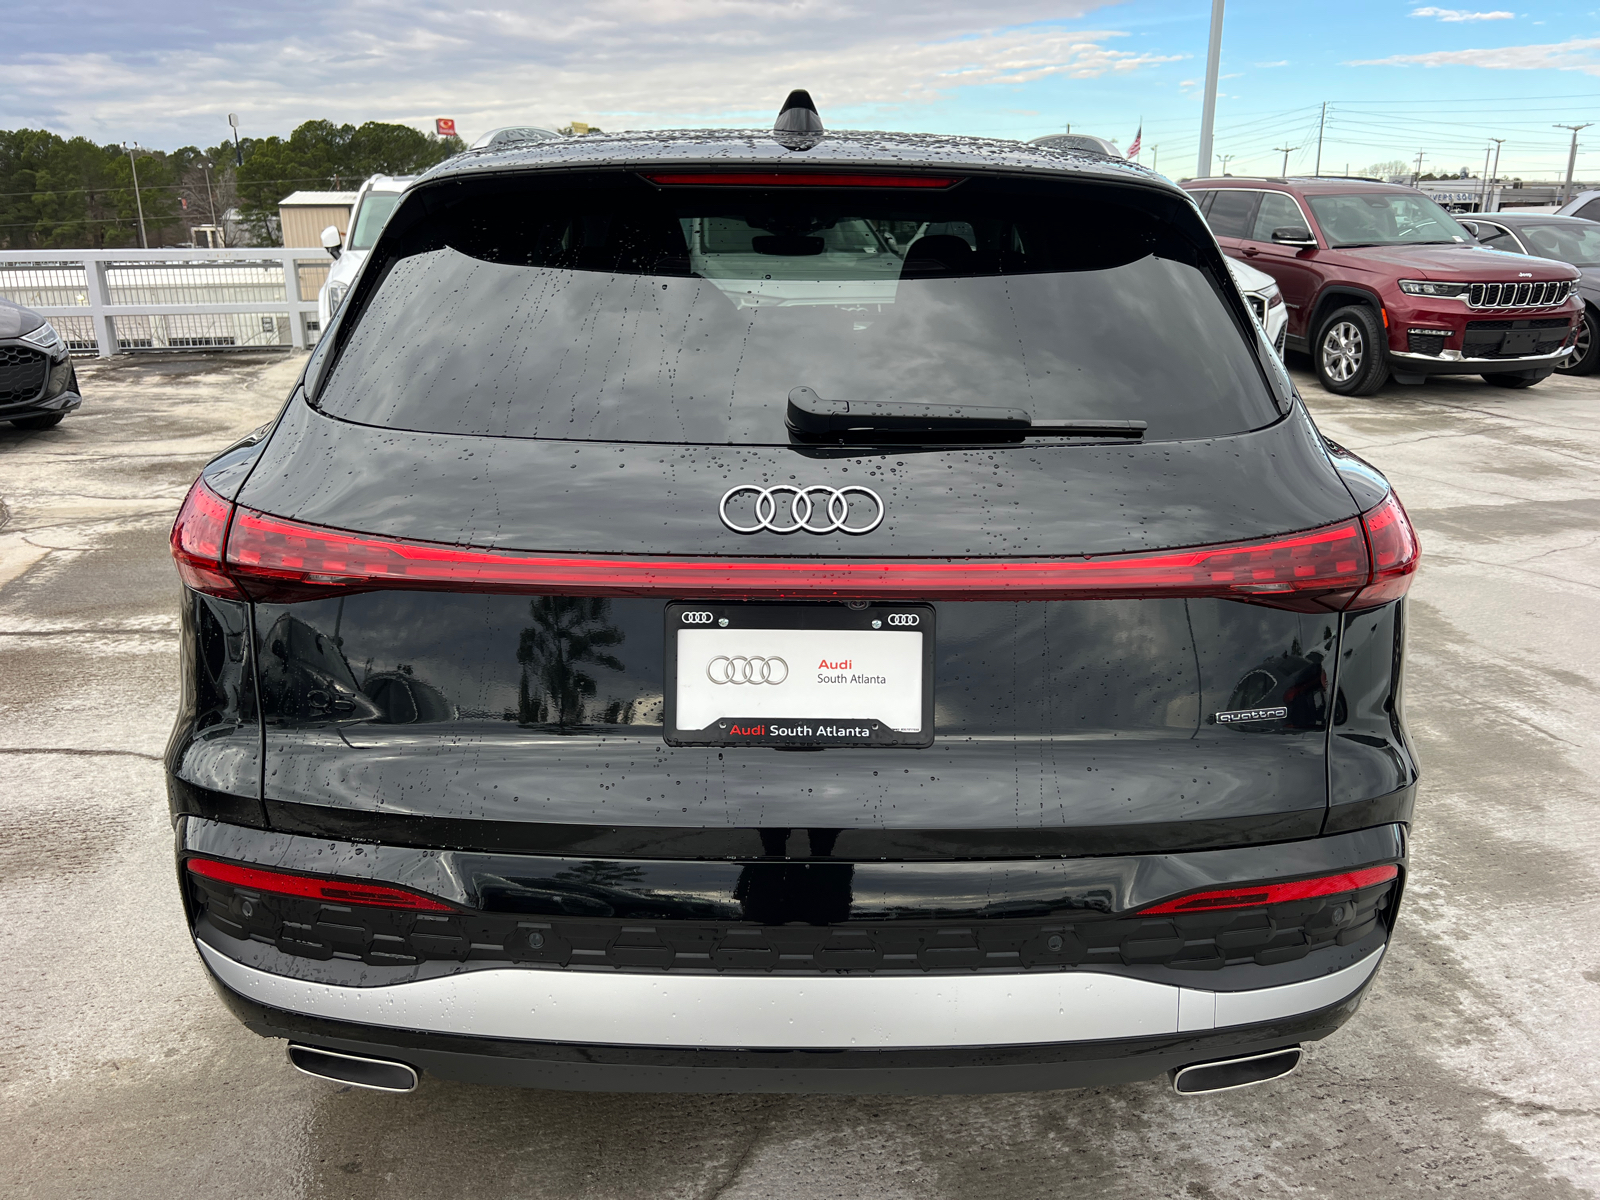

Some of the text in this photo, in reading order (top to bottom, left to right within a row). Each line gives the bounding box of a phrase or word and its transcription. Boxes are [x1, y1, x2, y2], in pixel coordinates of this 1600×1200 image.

[818, 659, 852, 670] Audi
[817, 673, 886, 685] South Atlanta
[307, 689, 357, 714] Q5
[1219, 709, 1285, 723] quattro
[729, 724, 870, 737] Audi South Atlanta
